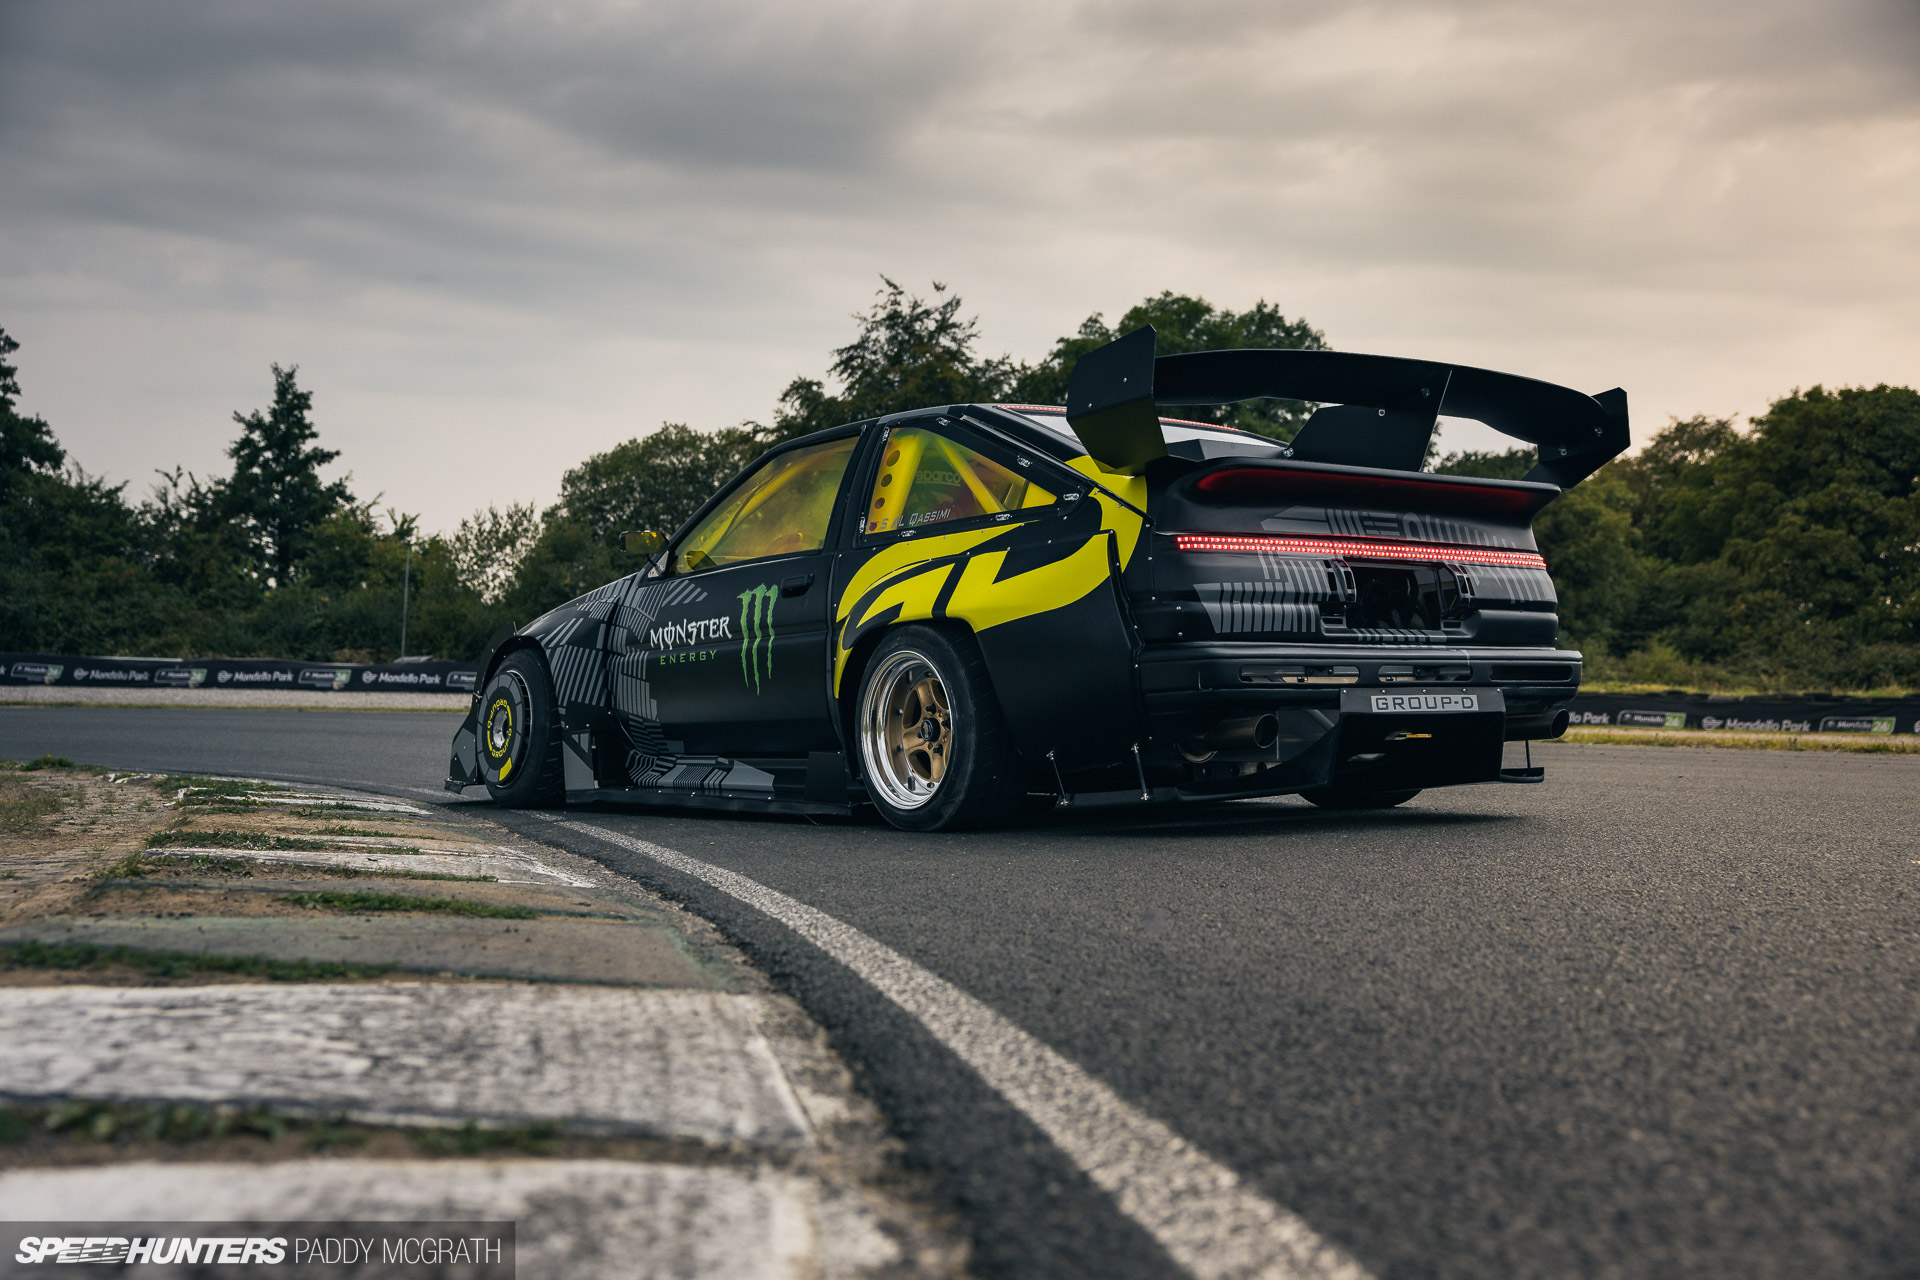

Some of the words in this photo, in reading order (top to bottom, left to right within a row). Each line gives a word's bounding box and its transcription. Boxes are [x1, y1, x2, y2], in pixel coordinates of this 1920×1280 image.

[916, 470, 961, 485] sparco
[891, 516, 904, 528] AL
[650, 616, 732, 650] MONSTER
[660, 650, 717, 665] ENERGY
[128, 670, 150, 682] Park
[233, 670, 272, 682] Mondello
[272, 670, 294, 682] Park
[378, 672, 418, 684] Mondello
[419, 673, 442, 685] Park
[1375, 696, 1474, 711] GROUP-D
[1583, 711, 1610, 725] Park
[1725, 717, 1780, 732] Mondello
[1781, 719, 1811, 733] Park
